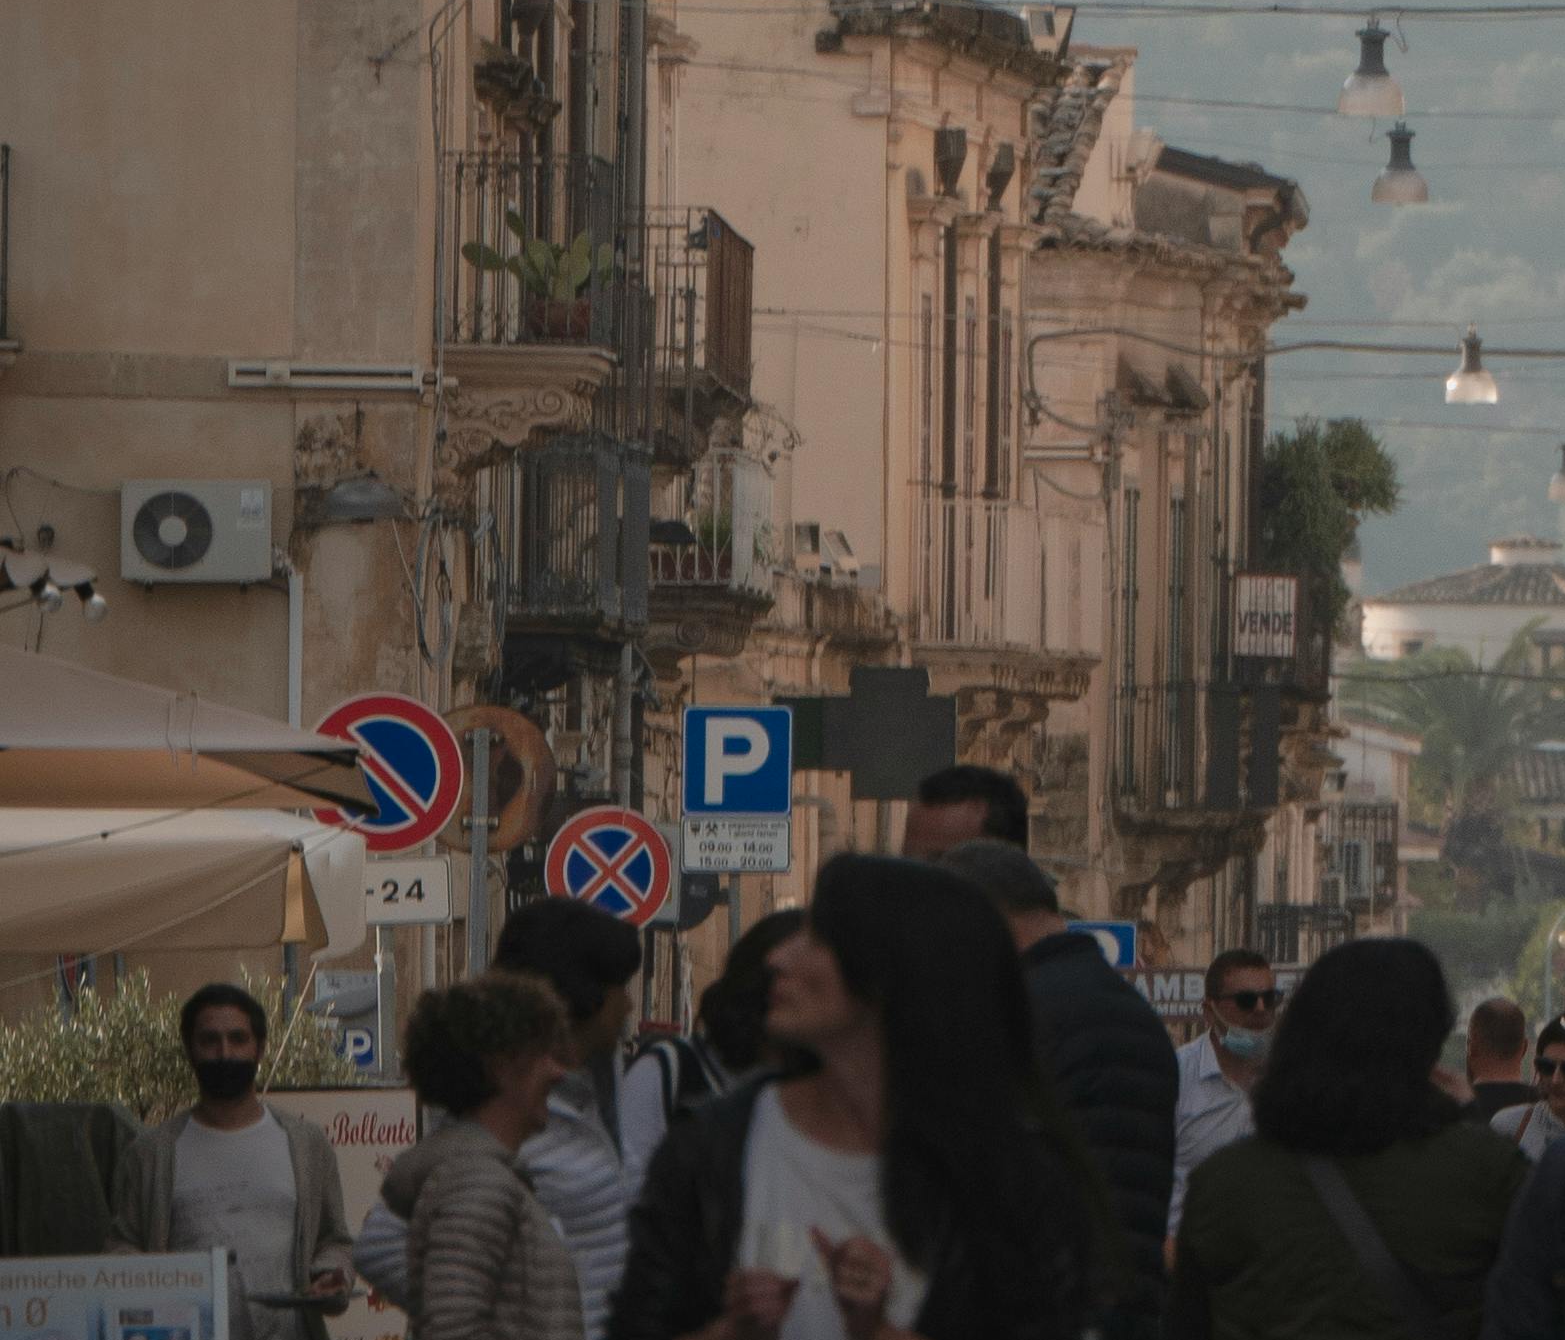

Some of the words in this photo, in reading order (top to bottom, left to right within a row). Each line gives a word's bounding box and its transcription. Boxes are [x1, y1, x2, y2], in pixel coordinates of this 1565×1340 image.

[1238, 612, 1293, 636] VENDE
[703, 716, 770, 805] P
[345, 1029, 372, 1059] P
[331, 1110, 415, 1149] Bollente
[93, 1265, 204, 1290] Artistiche
